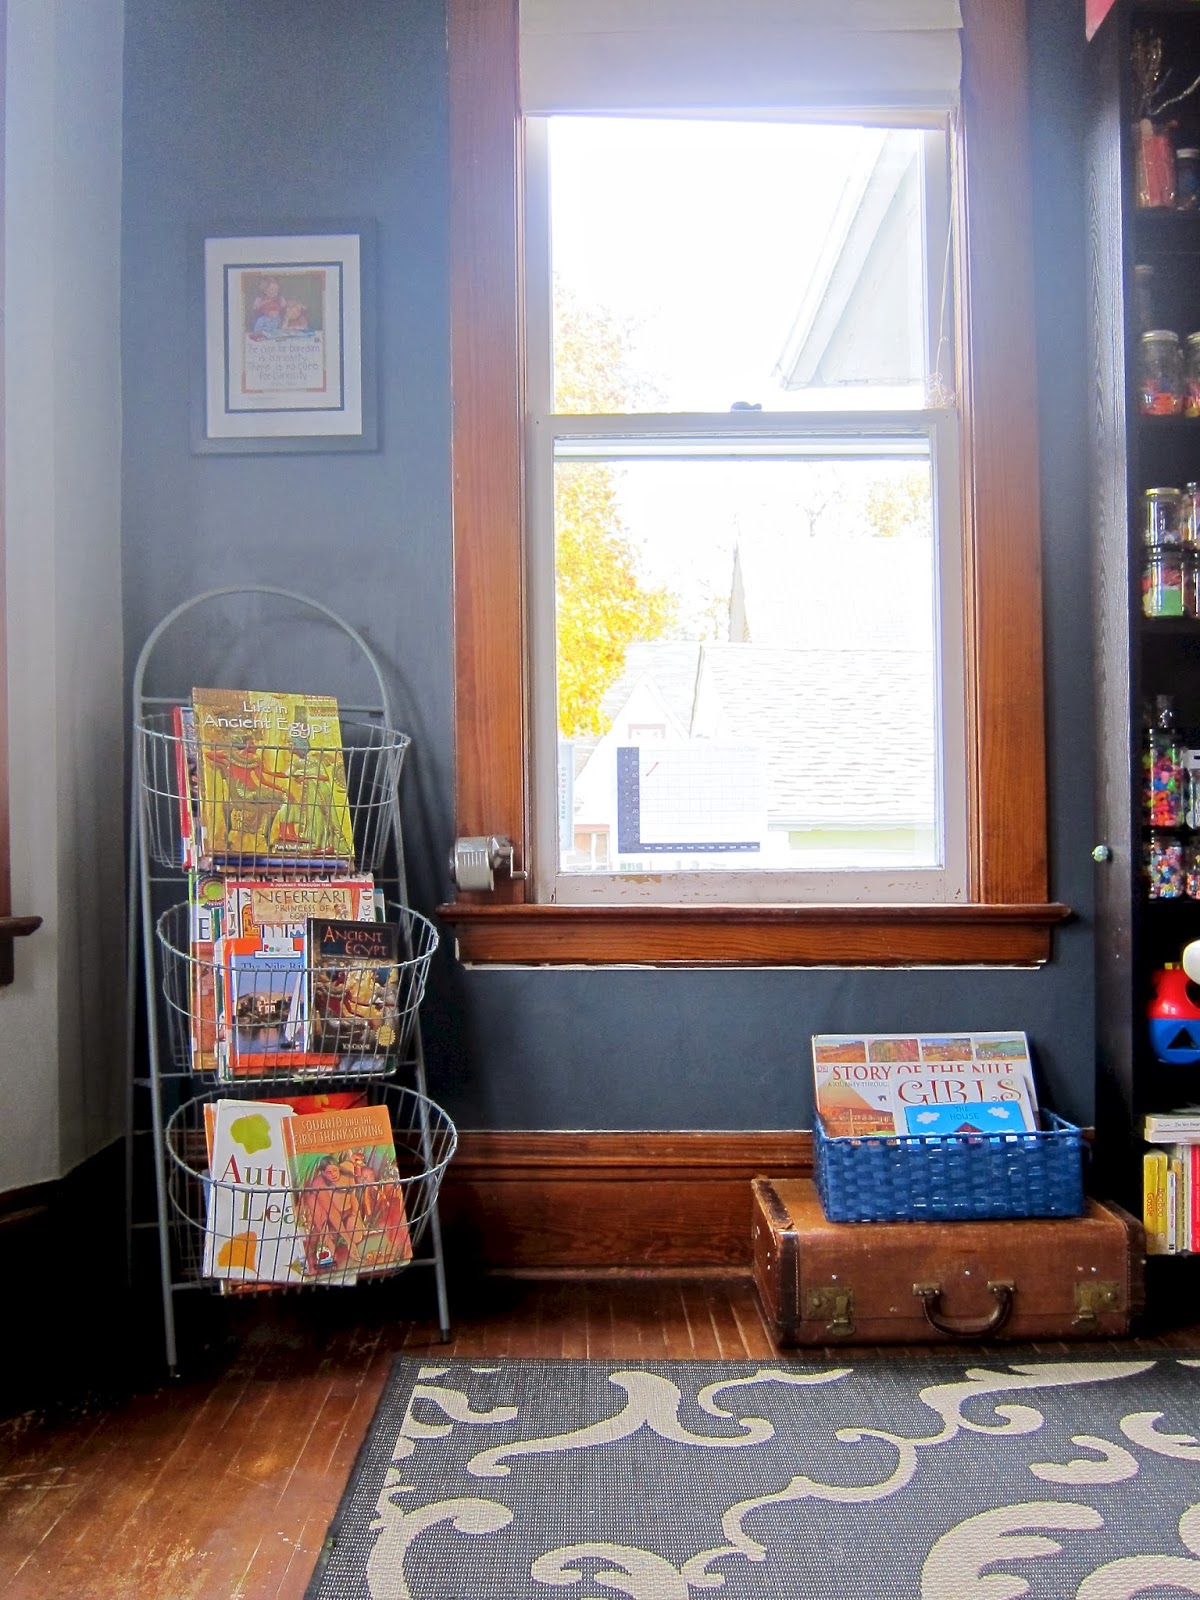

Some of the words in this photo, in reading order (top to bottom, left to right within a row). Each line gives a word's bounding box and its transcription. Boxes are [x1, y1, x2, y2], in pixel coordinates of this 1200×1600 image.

[243, 700, 272, 713] Life
[275, 703, 288, 714] in
[203, 714, 271, 730] Ancient
[276, 717, 331, 739] Egypt
[257, 890, 346, 903] NEFERTARI
[275, 904, 316, 912] PRINCESS
[323, 926, 383, 943] ANCIENT
[345, 941, 387, 956] EGYPT
[832, 1066, 892, 1081] STORY
[898, 1079, 1022, 1105] GIRLS
[319, 1124, 384, 1143] THANKSGIVING
